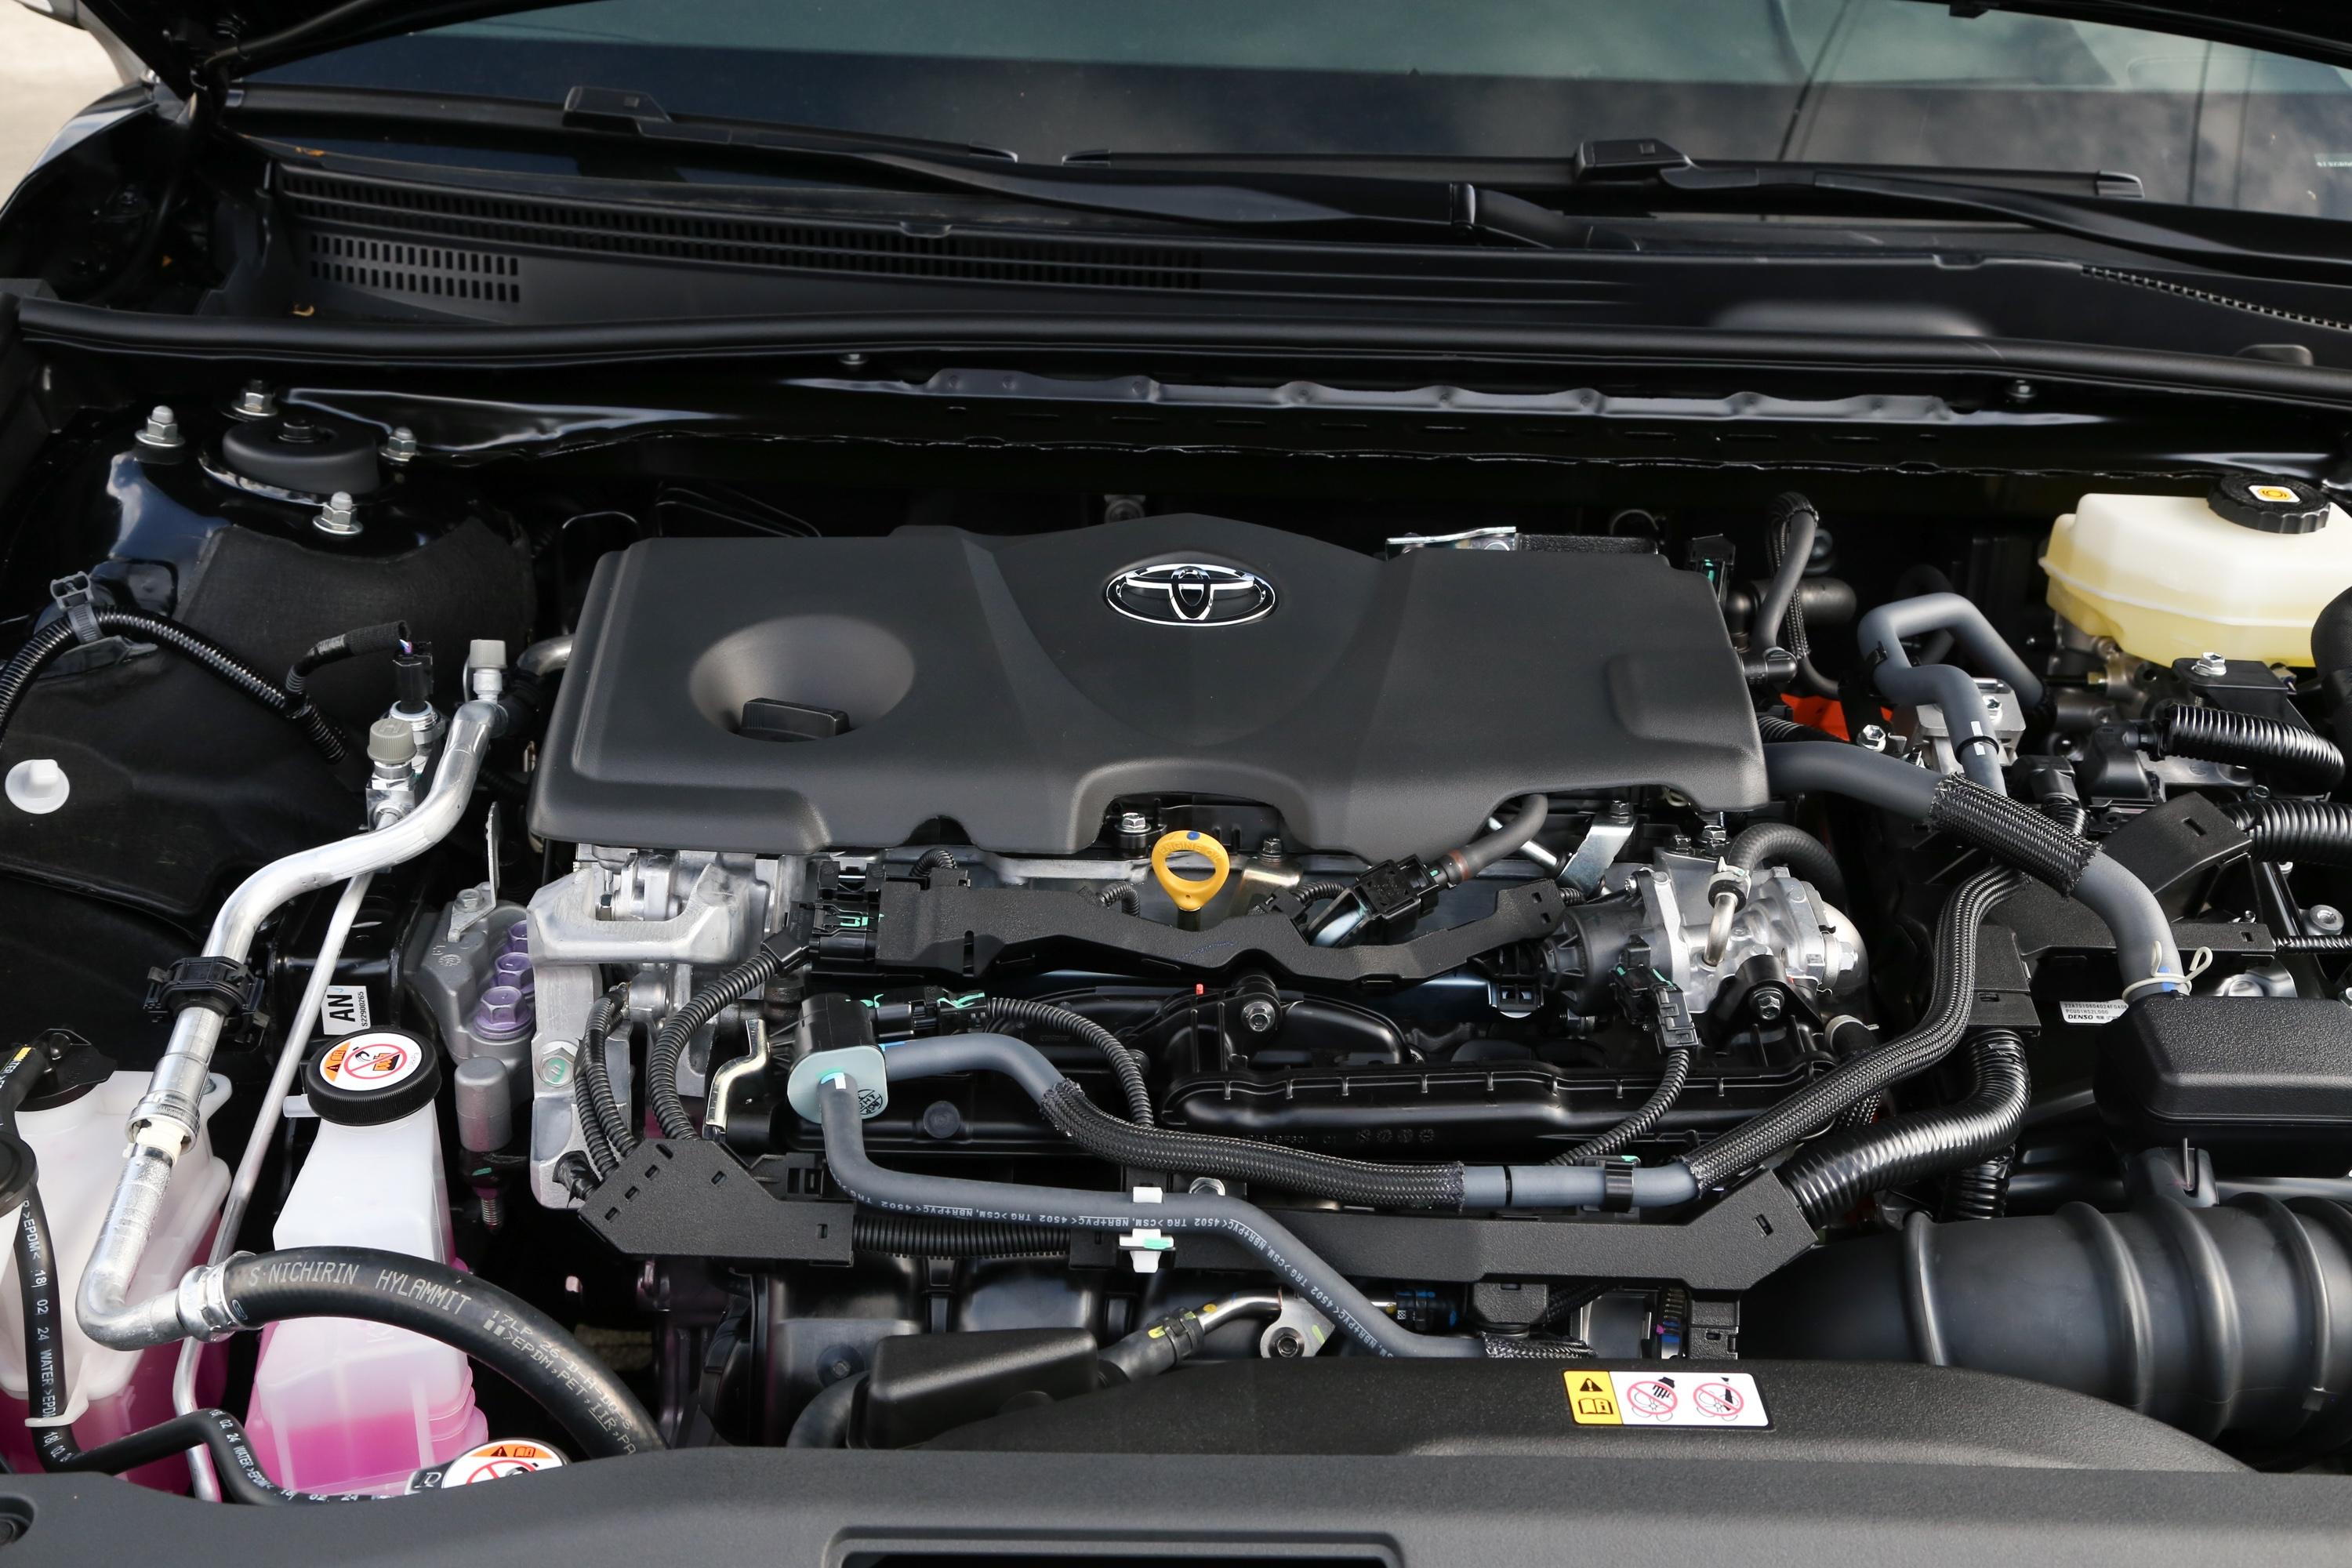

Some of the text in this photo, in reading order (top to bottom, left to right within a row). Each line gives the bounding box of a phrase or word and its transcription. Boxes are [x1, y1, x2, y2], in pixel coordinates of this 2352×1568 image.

[1159, 840, 1221, 862] ENGINE OIL
[327, 994, 355, 1022] AN
[880, 1200, 912, 1211] 4502
[1011, 1213, 1031, 1221] TRG
[1039, 1214, 1067, 1224] 4502
[1167, 1218, 1187, 1227] TRG
[1194, 1218, 1220, 1227] 4502
[1290, 1268, 1308, 1287] TRG
[375, 1269, 473, 1315] HYLAMMIT
[1310, 1285, 1334, 1308] 4502
[37, 1299, 49, 1315] 02
[37, 1327, 49, 1341] 24
[40, 1348, 54, 1387] WATER
[219, 1418, 234, 1429] 02
[233, 1445, 254, 1468] WATER
